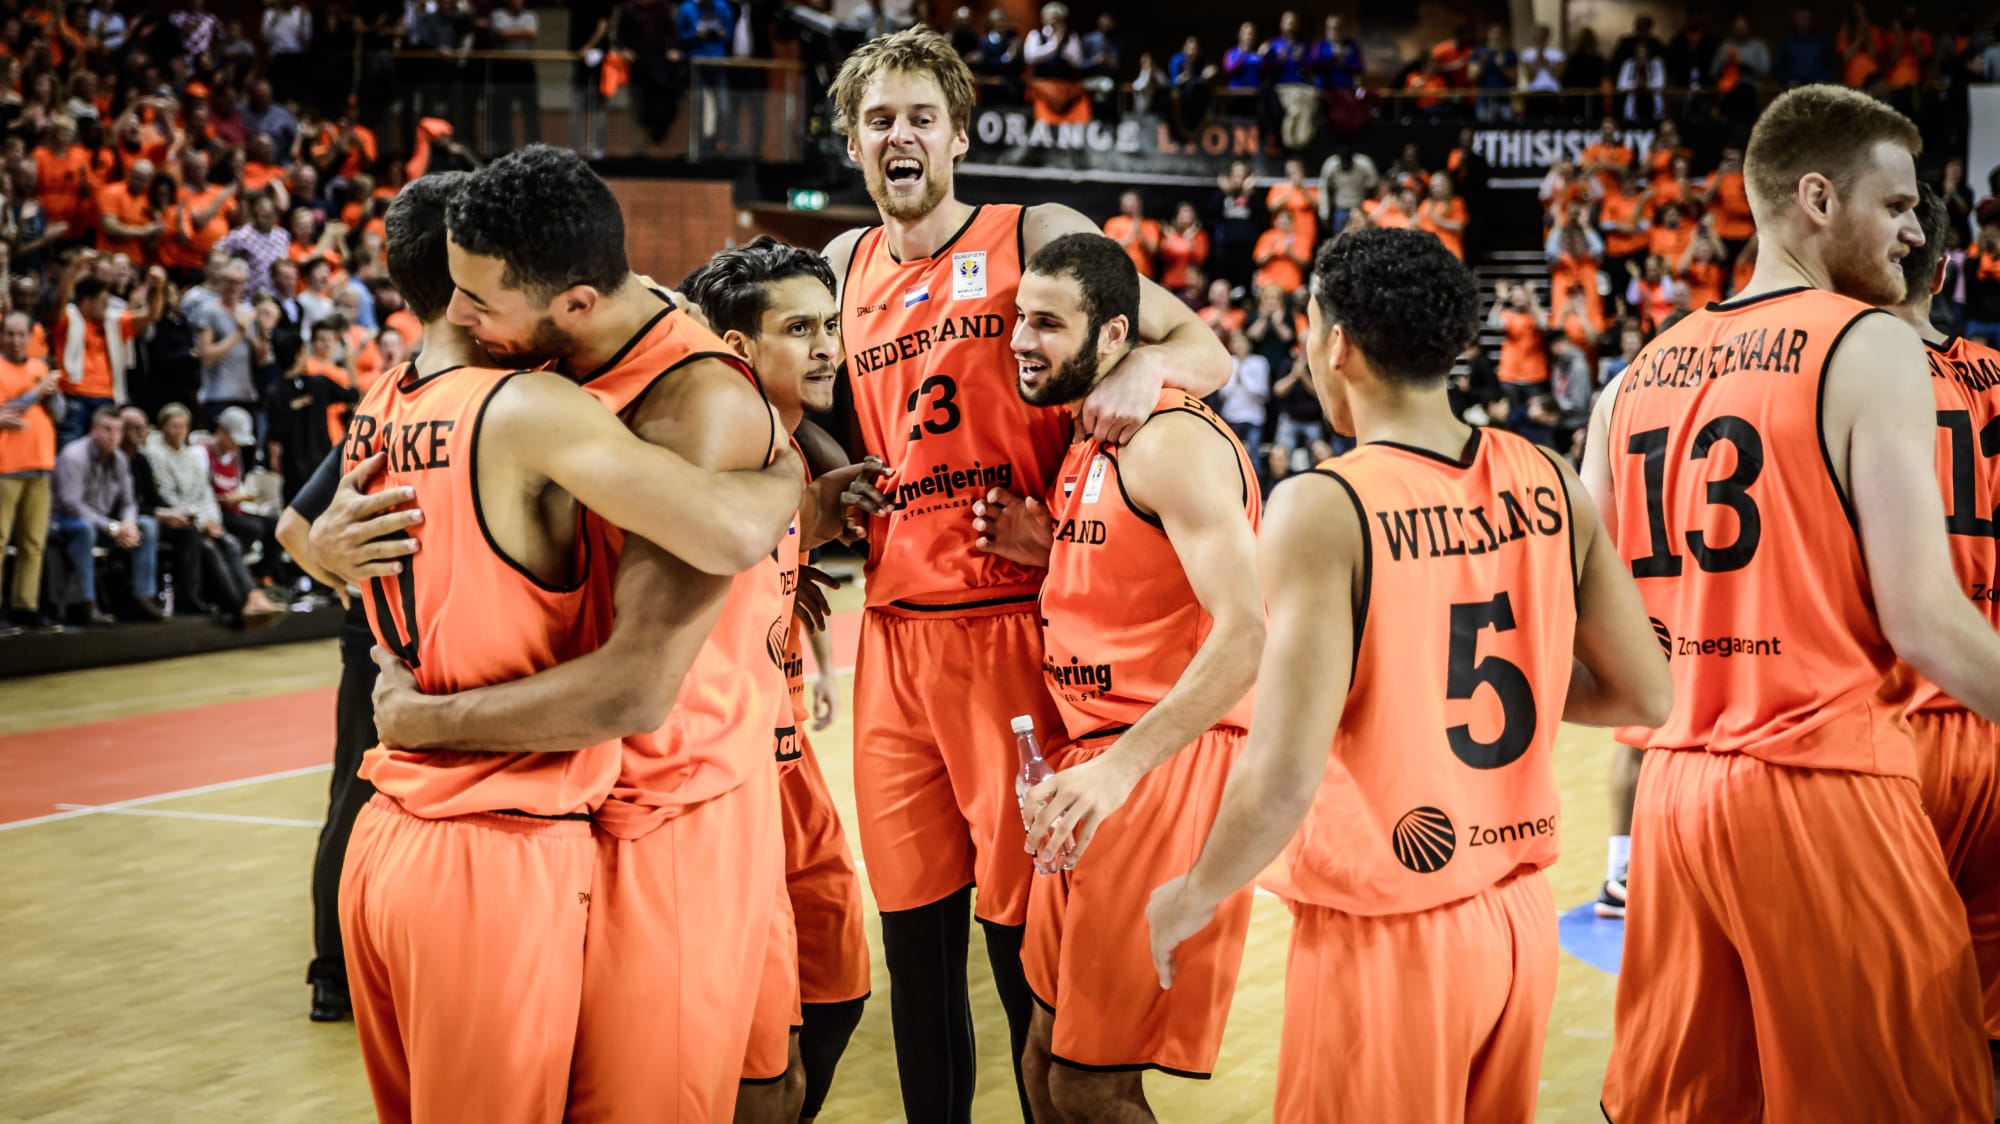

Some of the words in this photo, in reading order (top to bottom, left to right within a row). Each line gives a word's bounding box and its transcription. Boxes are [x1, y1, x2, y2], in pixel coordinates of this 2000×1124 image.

[976, 110, 1142, 153] ORANGE
[1627, 415, 1764, 579] 13
[1446, 591, 1537, 770] 5
